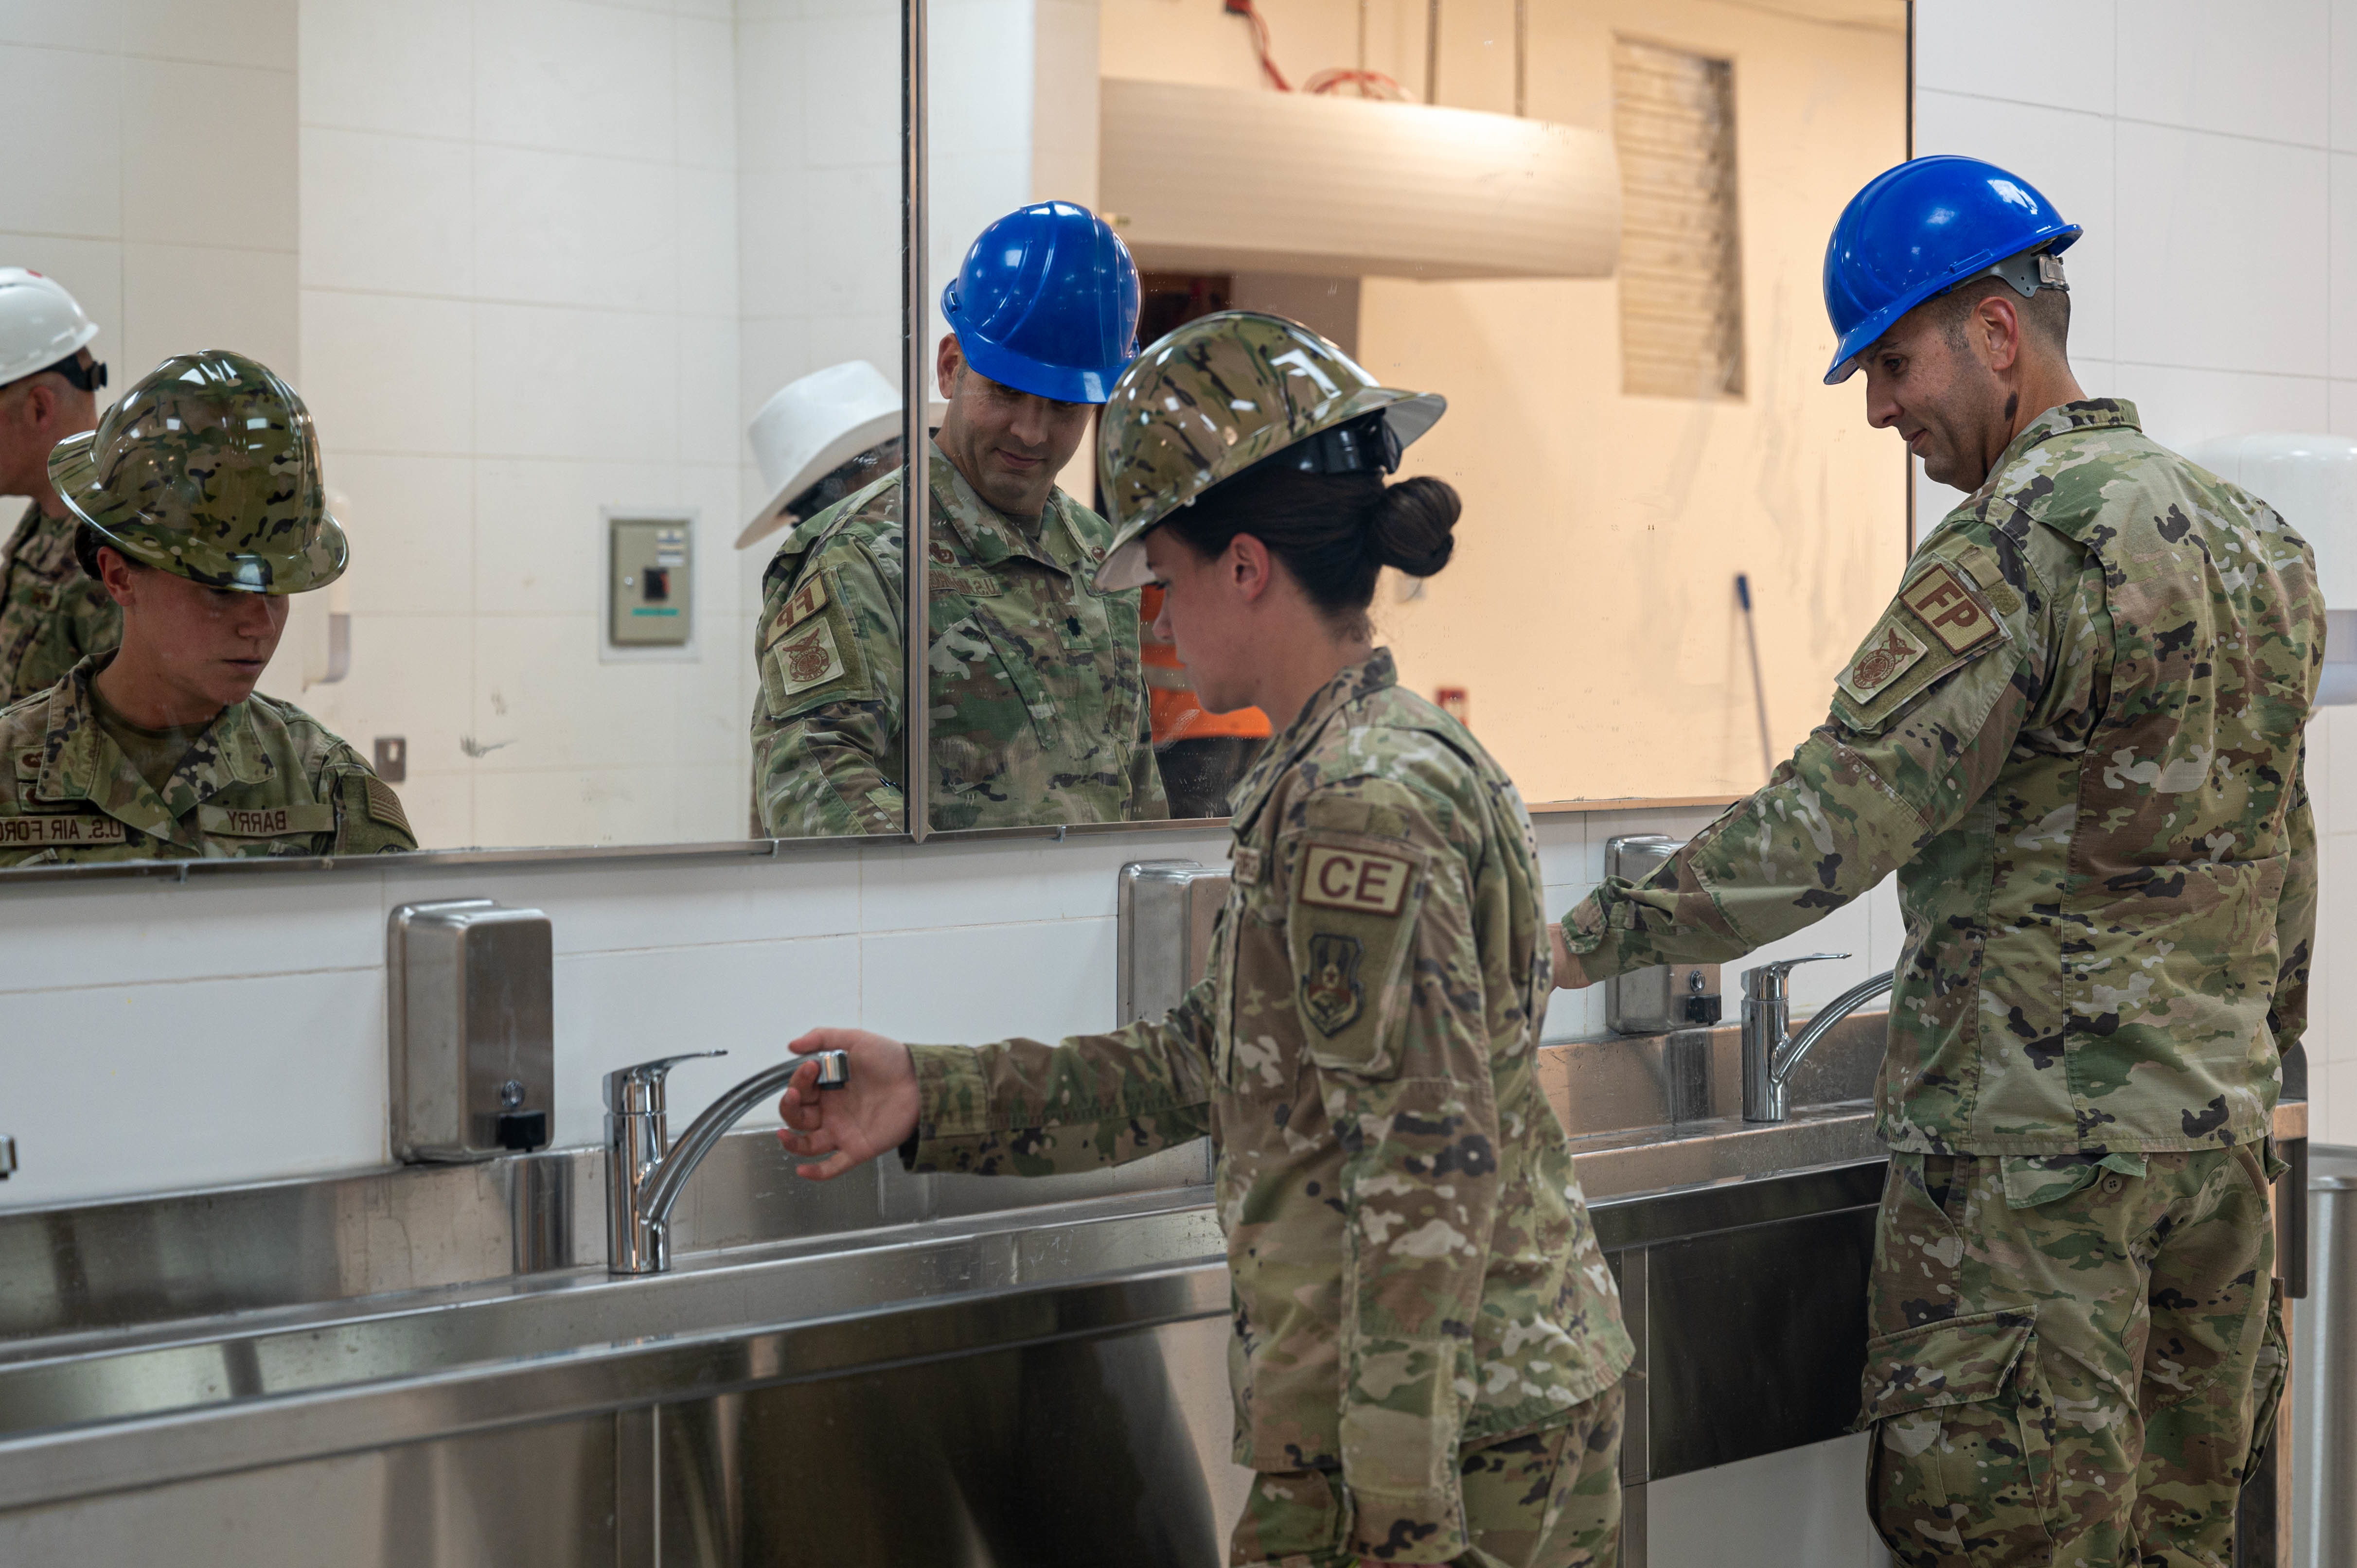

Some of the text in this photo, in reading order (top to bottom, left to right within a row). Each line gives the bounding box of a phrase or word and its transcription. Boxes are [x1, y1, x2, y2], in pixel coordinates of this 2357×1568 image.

[1914, 581, 1979, 628] FP
[1863, 650, 1895, 680] FIRE PROTECTION
[1319, 856, 1392, 903] CE
